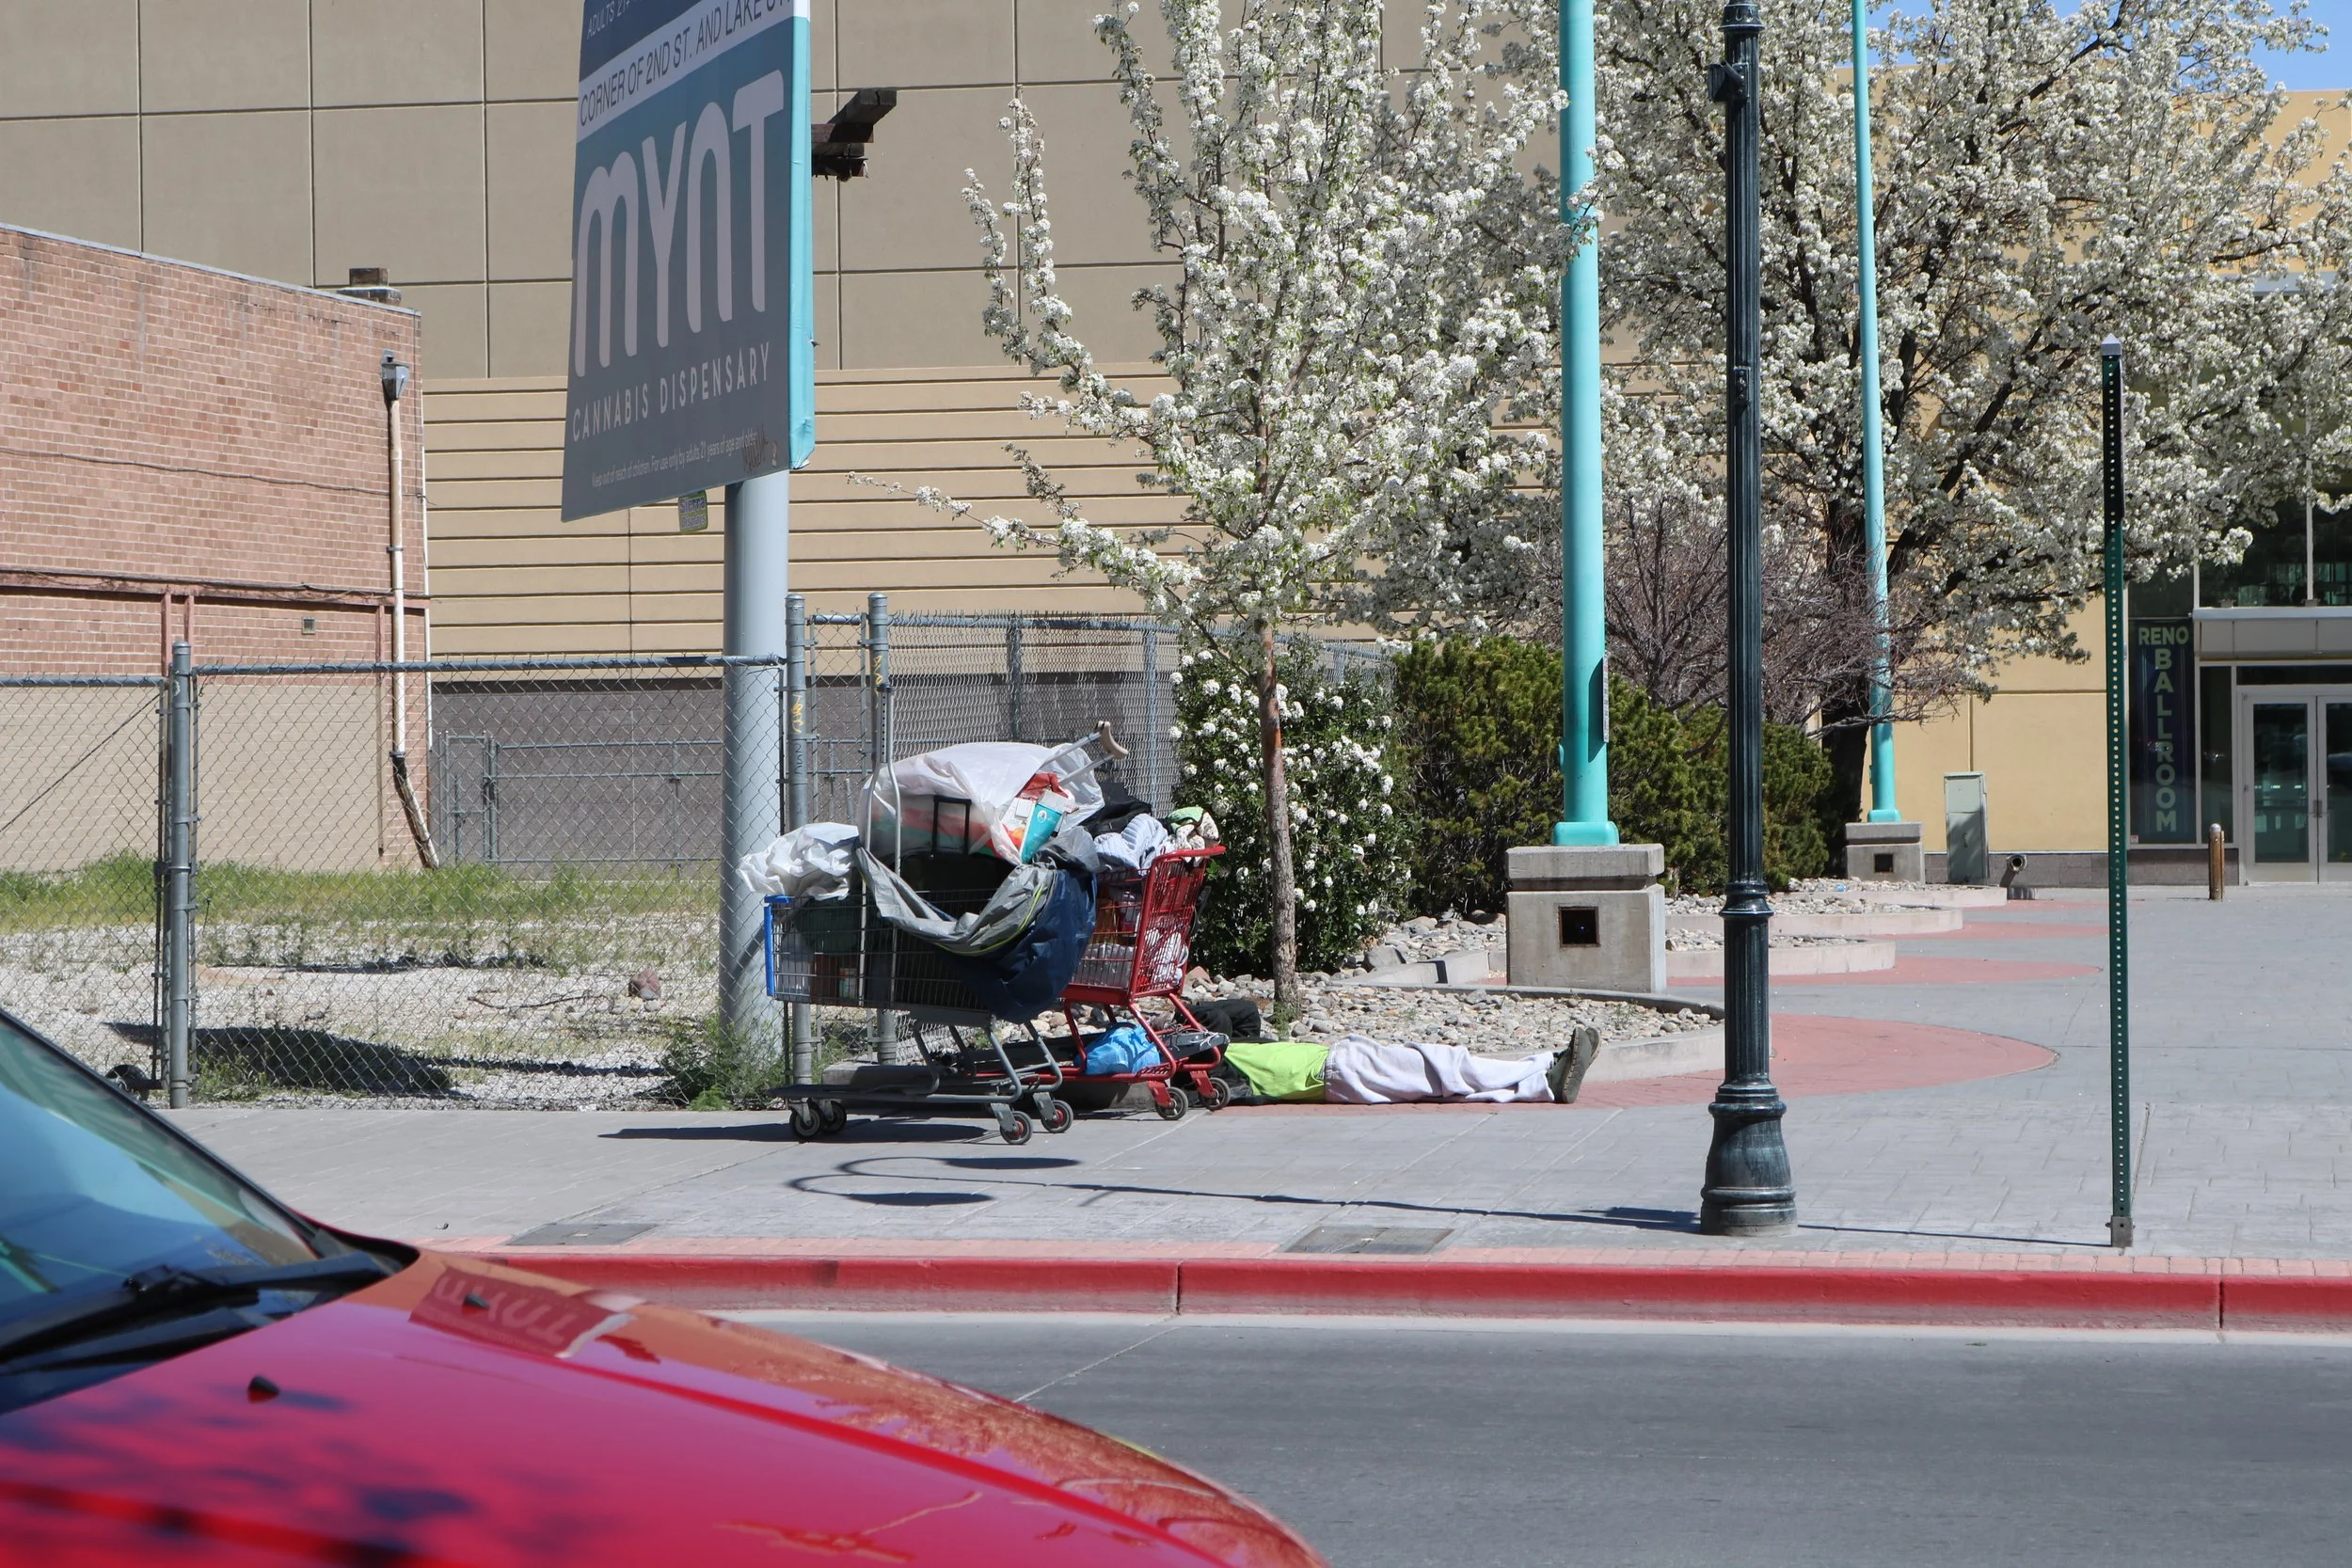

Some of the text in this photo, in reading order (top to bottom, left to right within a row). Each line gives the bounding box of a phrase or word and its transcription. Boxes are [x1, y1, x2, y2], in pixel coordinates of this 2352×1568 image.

[580, 0, 762, 127] CORNER OF 2ND ST. AND LAKE
[586, 0, 614, 40] ADULTS
[572, 341, 770, 442] CANNABIS DISPENSARY
[2137, 626, 2189, 645] RENO
[2153, 648, 2177, 832] BALLROOM
